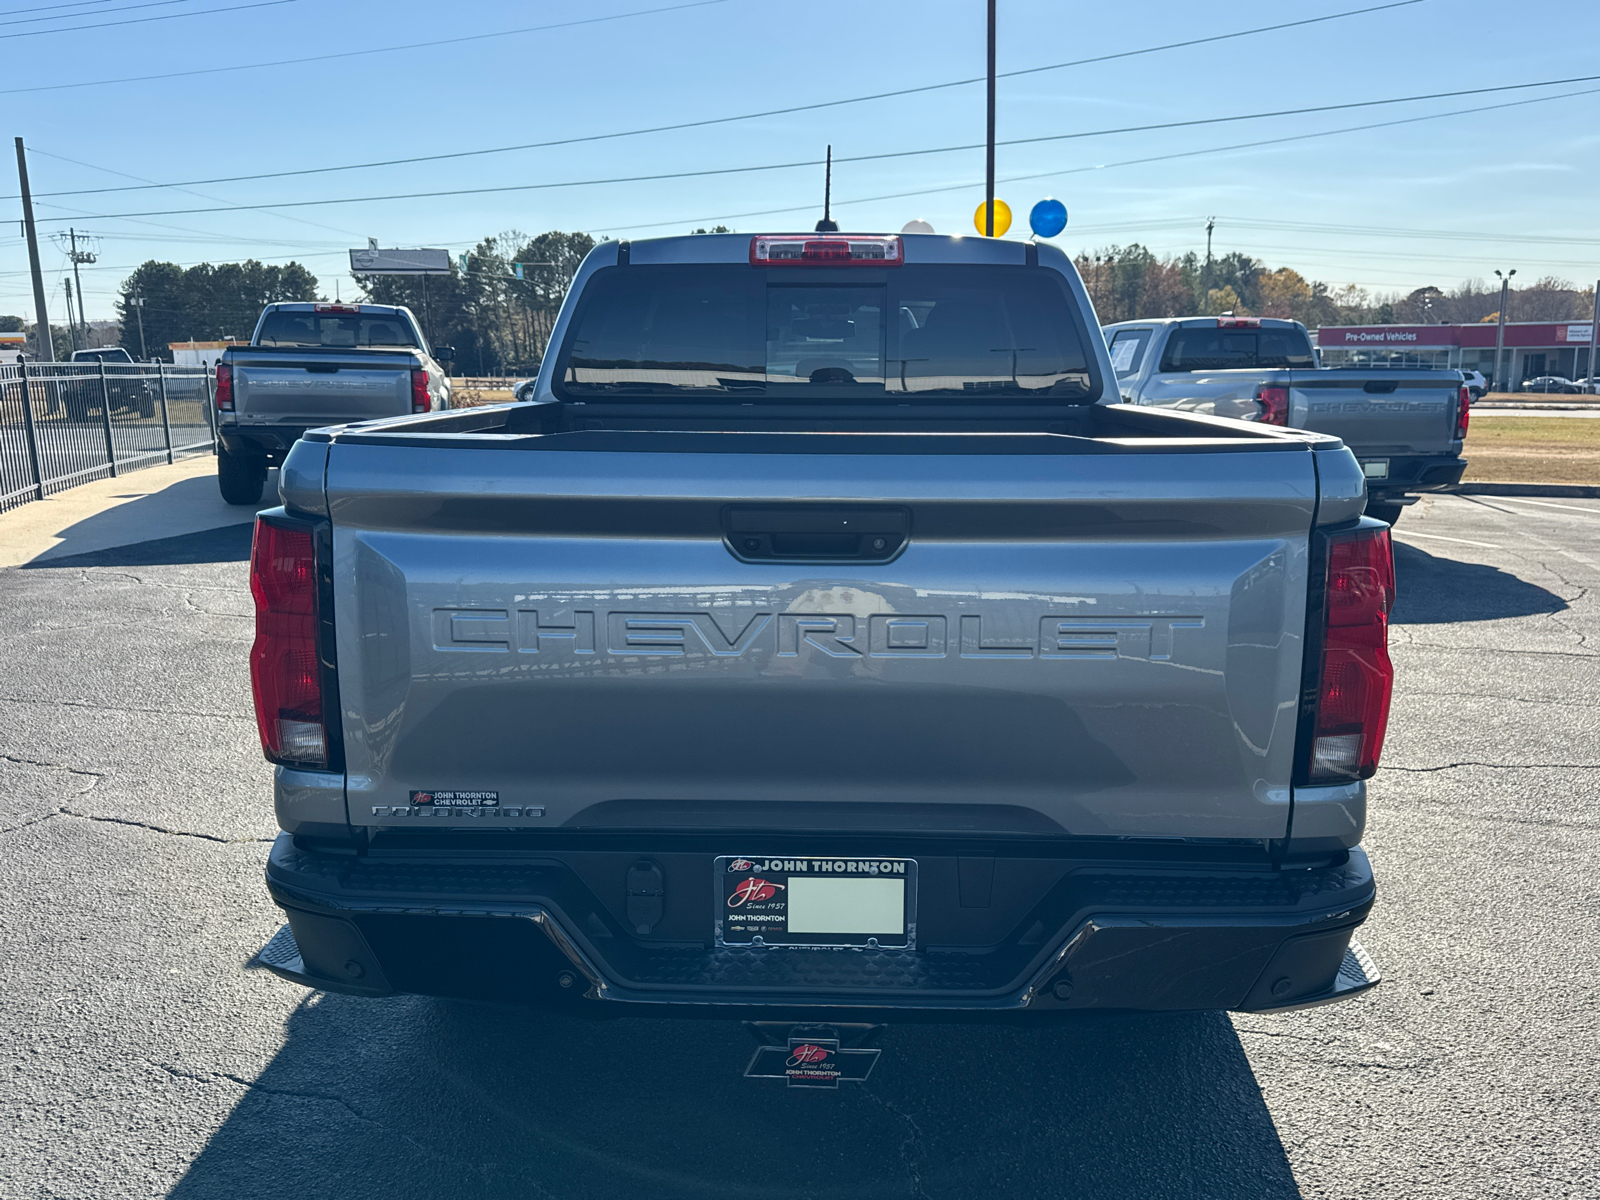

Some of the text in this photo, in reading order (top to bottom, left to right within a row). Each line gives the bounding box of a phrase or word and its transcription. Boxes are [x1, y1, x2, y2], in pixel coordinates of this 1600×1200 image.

[1345, 332, 1417, 341] Pre-Owned Vehicles
[1311, 402, 1446, 414] CHEVROLET
[431, 608, 1206, 662] CHEVROLET
[371, 805, 547, 817] COLORADO
[762, 860, 905, 873] JOHN THORNTON
